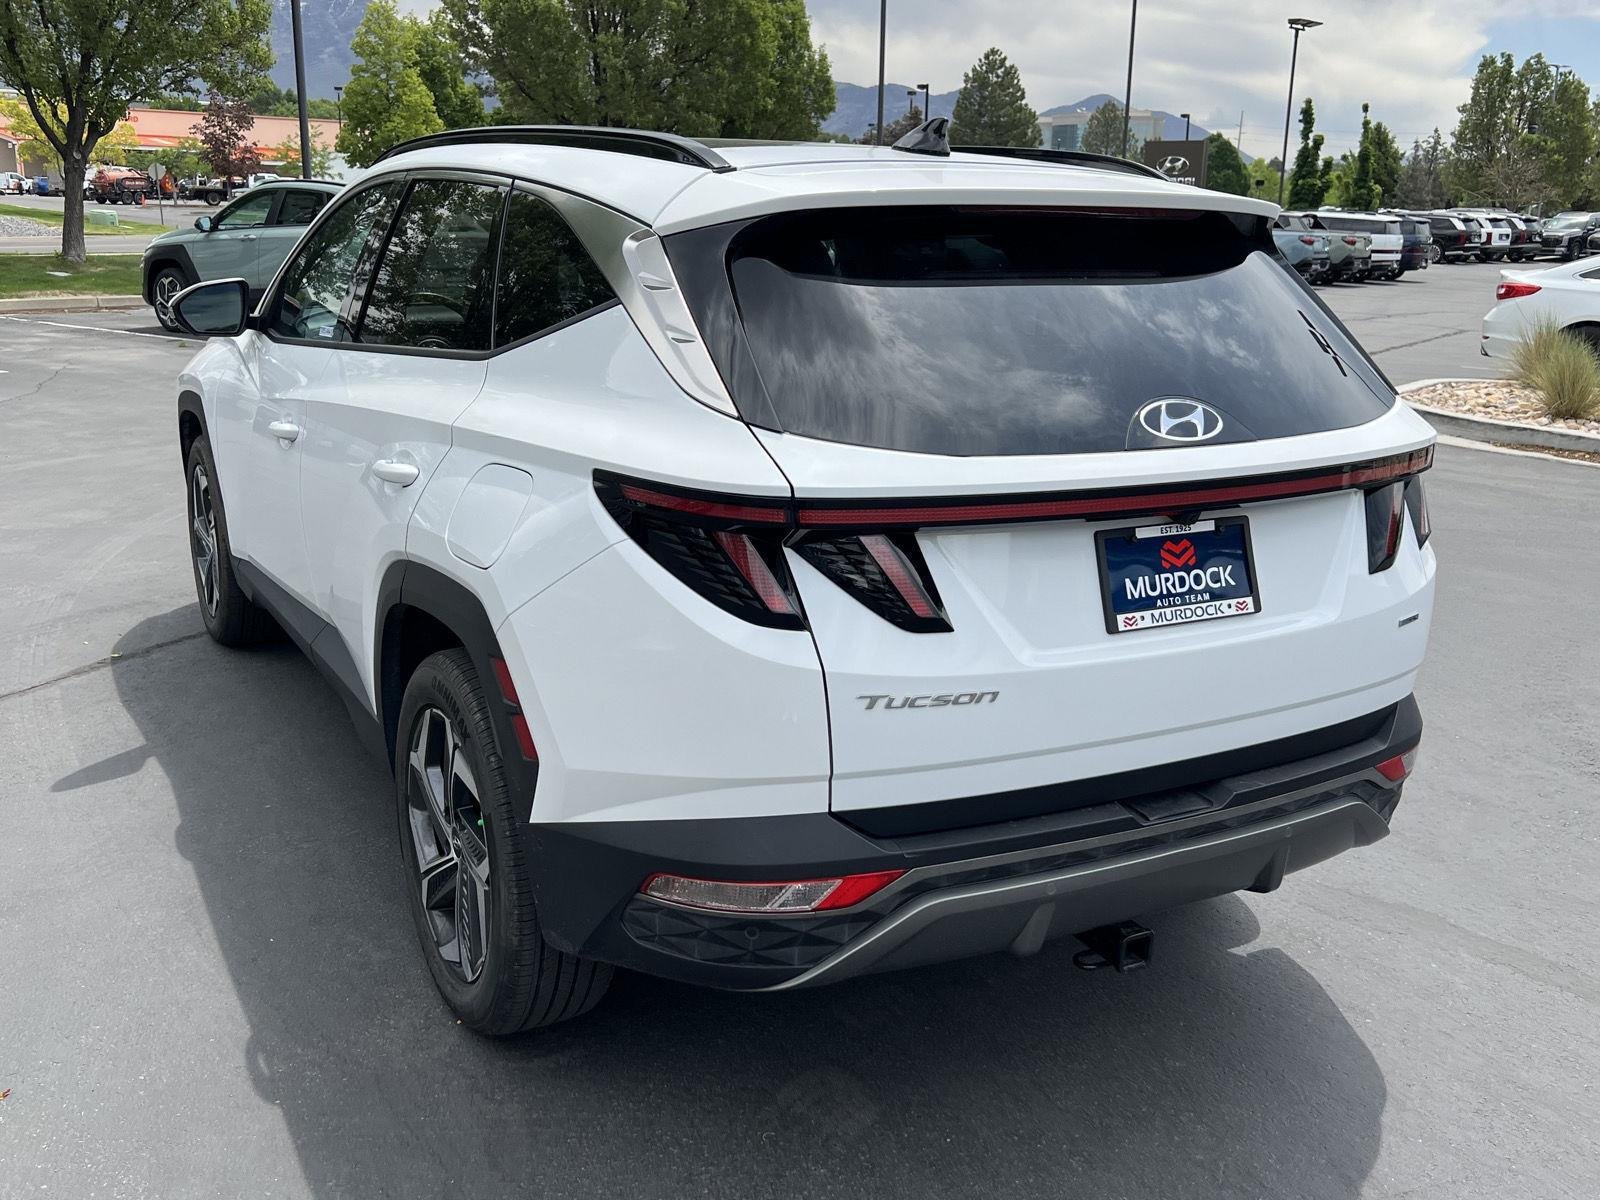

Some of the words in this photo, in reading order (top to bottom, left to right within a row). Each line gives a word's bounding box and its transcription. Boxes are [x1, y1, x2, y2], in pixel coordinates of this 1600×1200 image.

[1160, 526, 1175, 534] EST.
[1124, 565, 1236, 600] MURDOCK
[1156, 596, 1181, 607] AUTO
[1185, 593, 1211, 603] TEAM
[1150, 603, 1225, 624] MURDOCK
